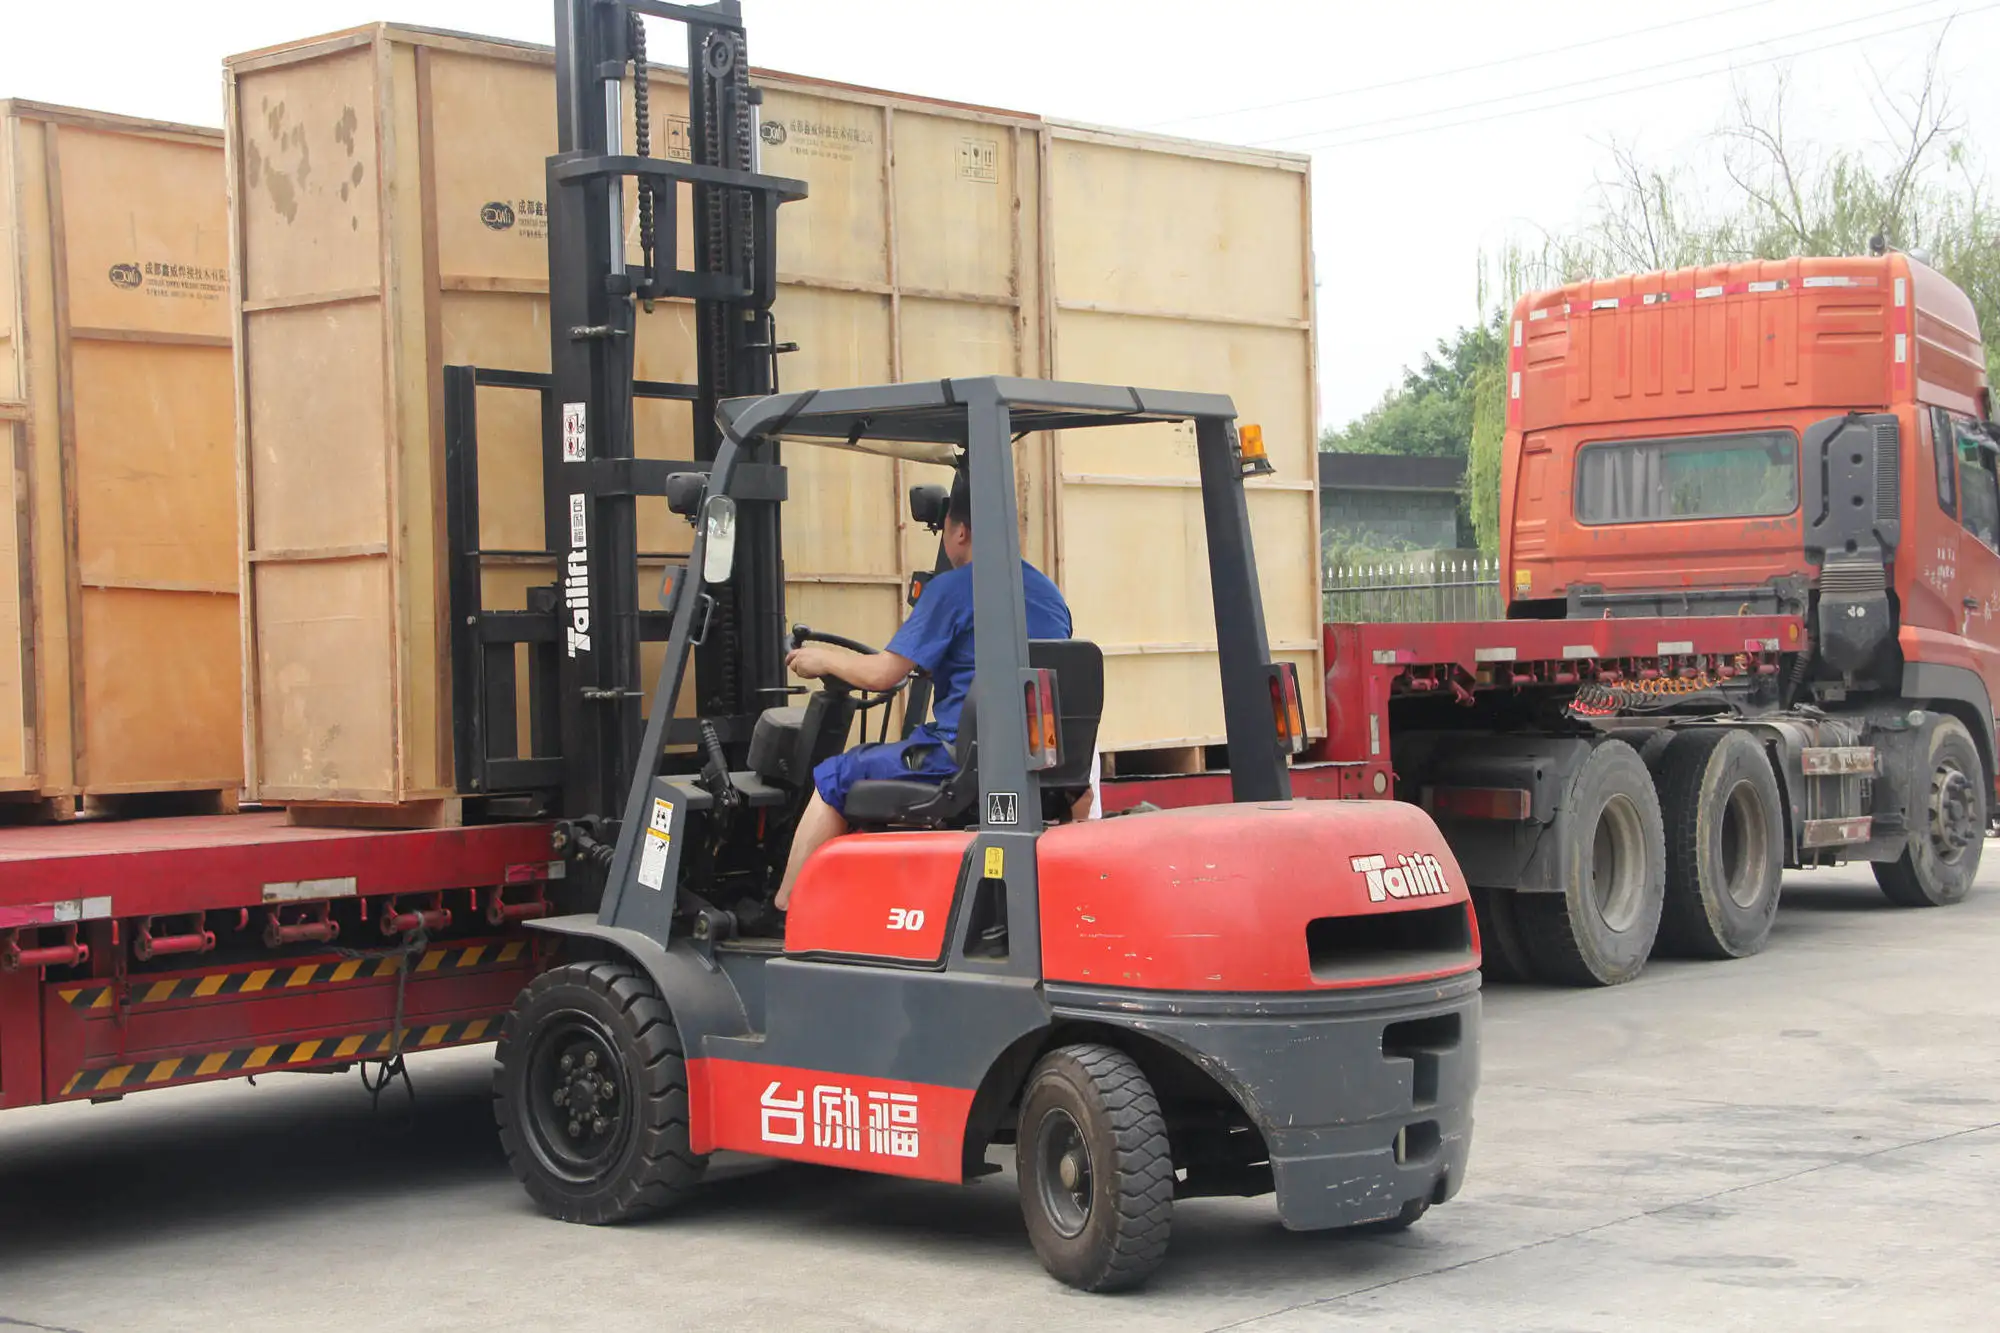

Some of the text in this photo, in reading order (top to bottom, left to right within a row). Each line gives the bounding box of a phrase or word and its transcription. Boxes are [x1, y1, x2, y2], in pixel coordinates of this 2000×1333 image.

[566, 549, 591, 660] Tailift
[1349, 852, 1450, 902] Tailift
[886, 907, 925, 931] 30
[760, 1081, 919, 1158] 台励福
